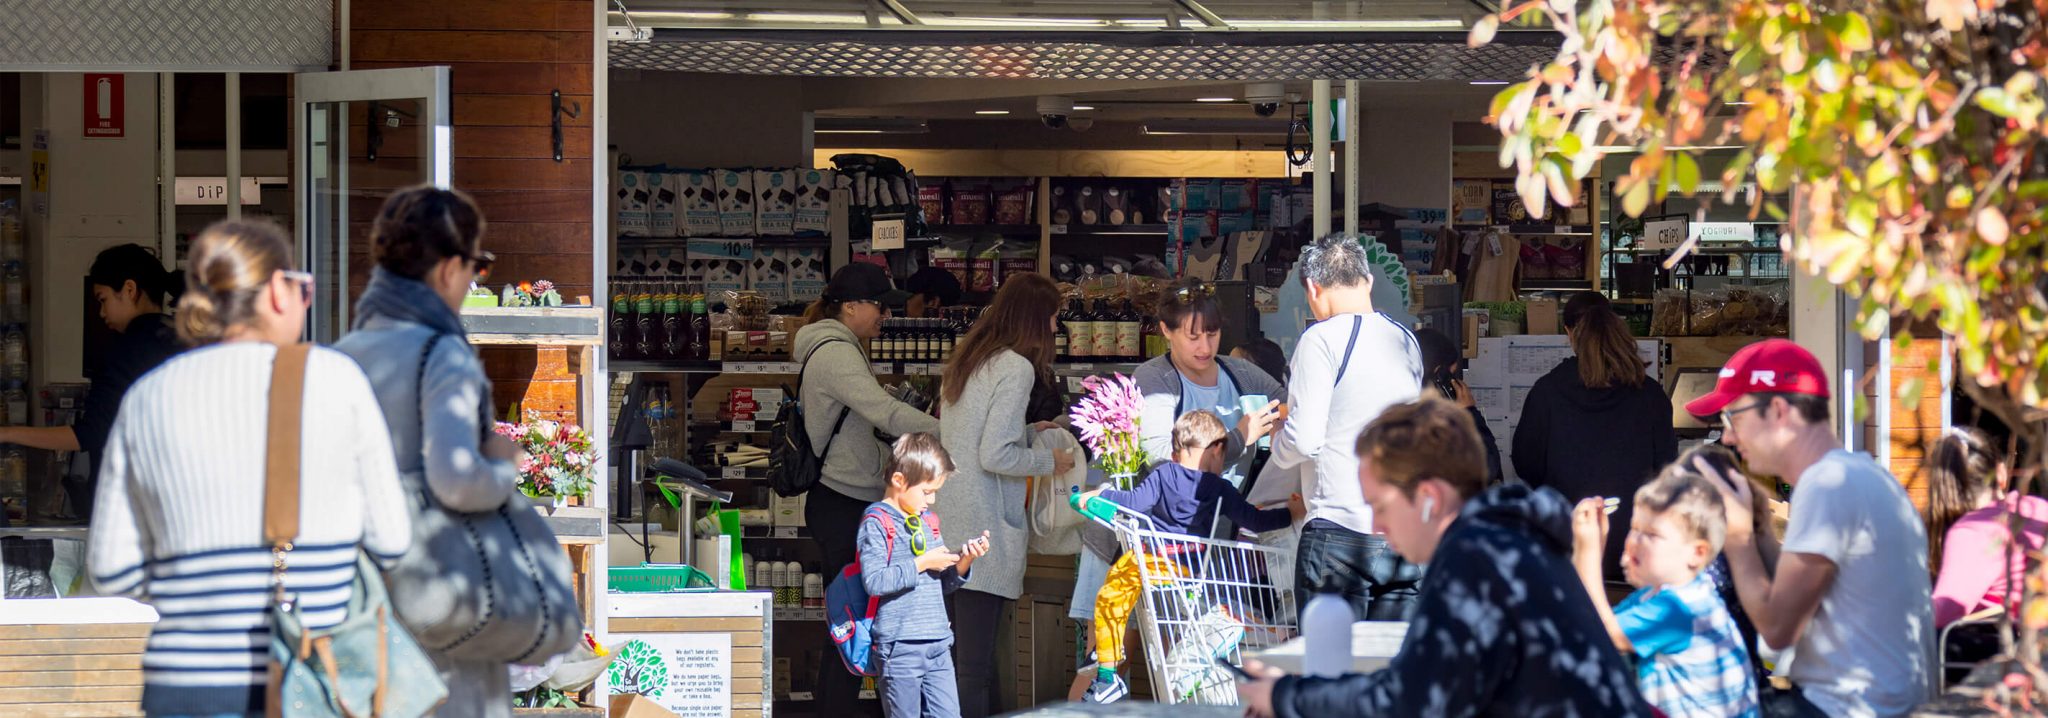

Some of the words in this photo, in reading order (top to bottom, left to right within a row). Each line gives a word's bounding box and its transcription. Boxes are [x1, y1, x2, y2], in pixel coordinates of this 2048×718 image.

[197, 185, 223, 199] DiP
[1463, 185, 1484, 198] CORN
[1750, 370, 1776, 387] R
